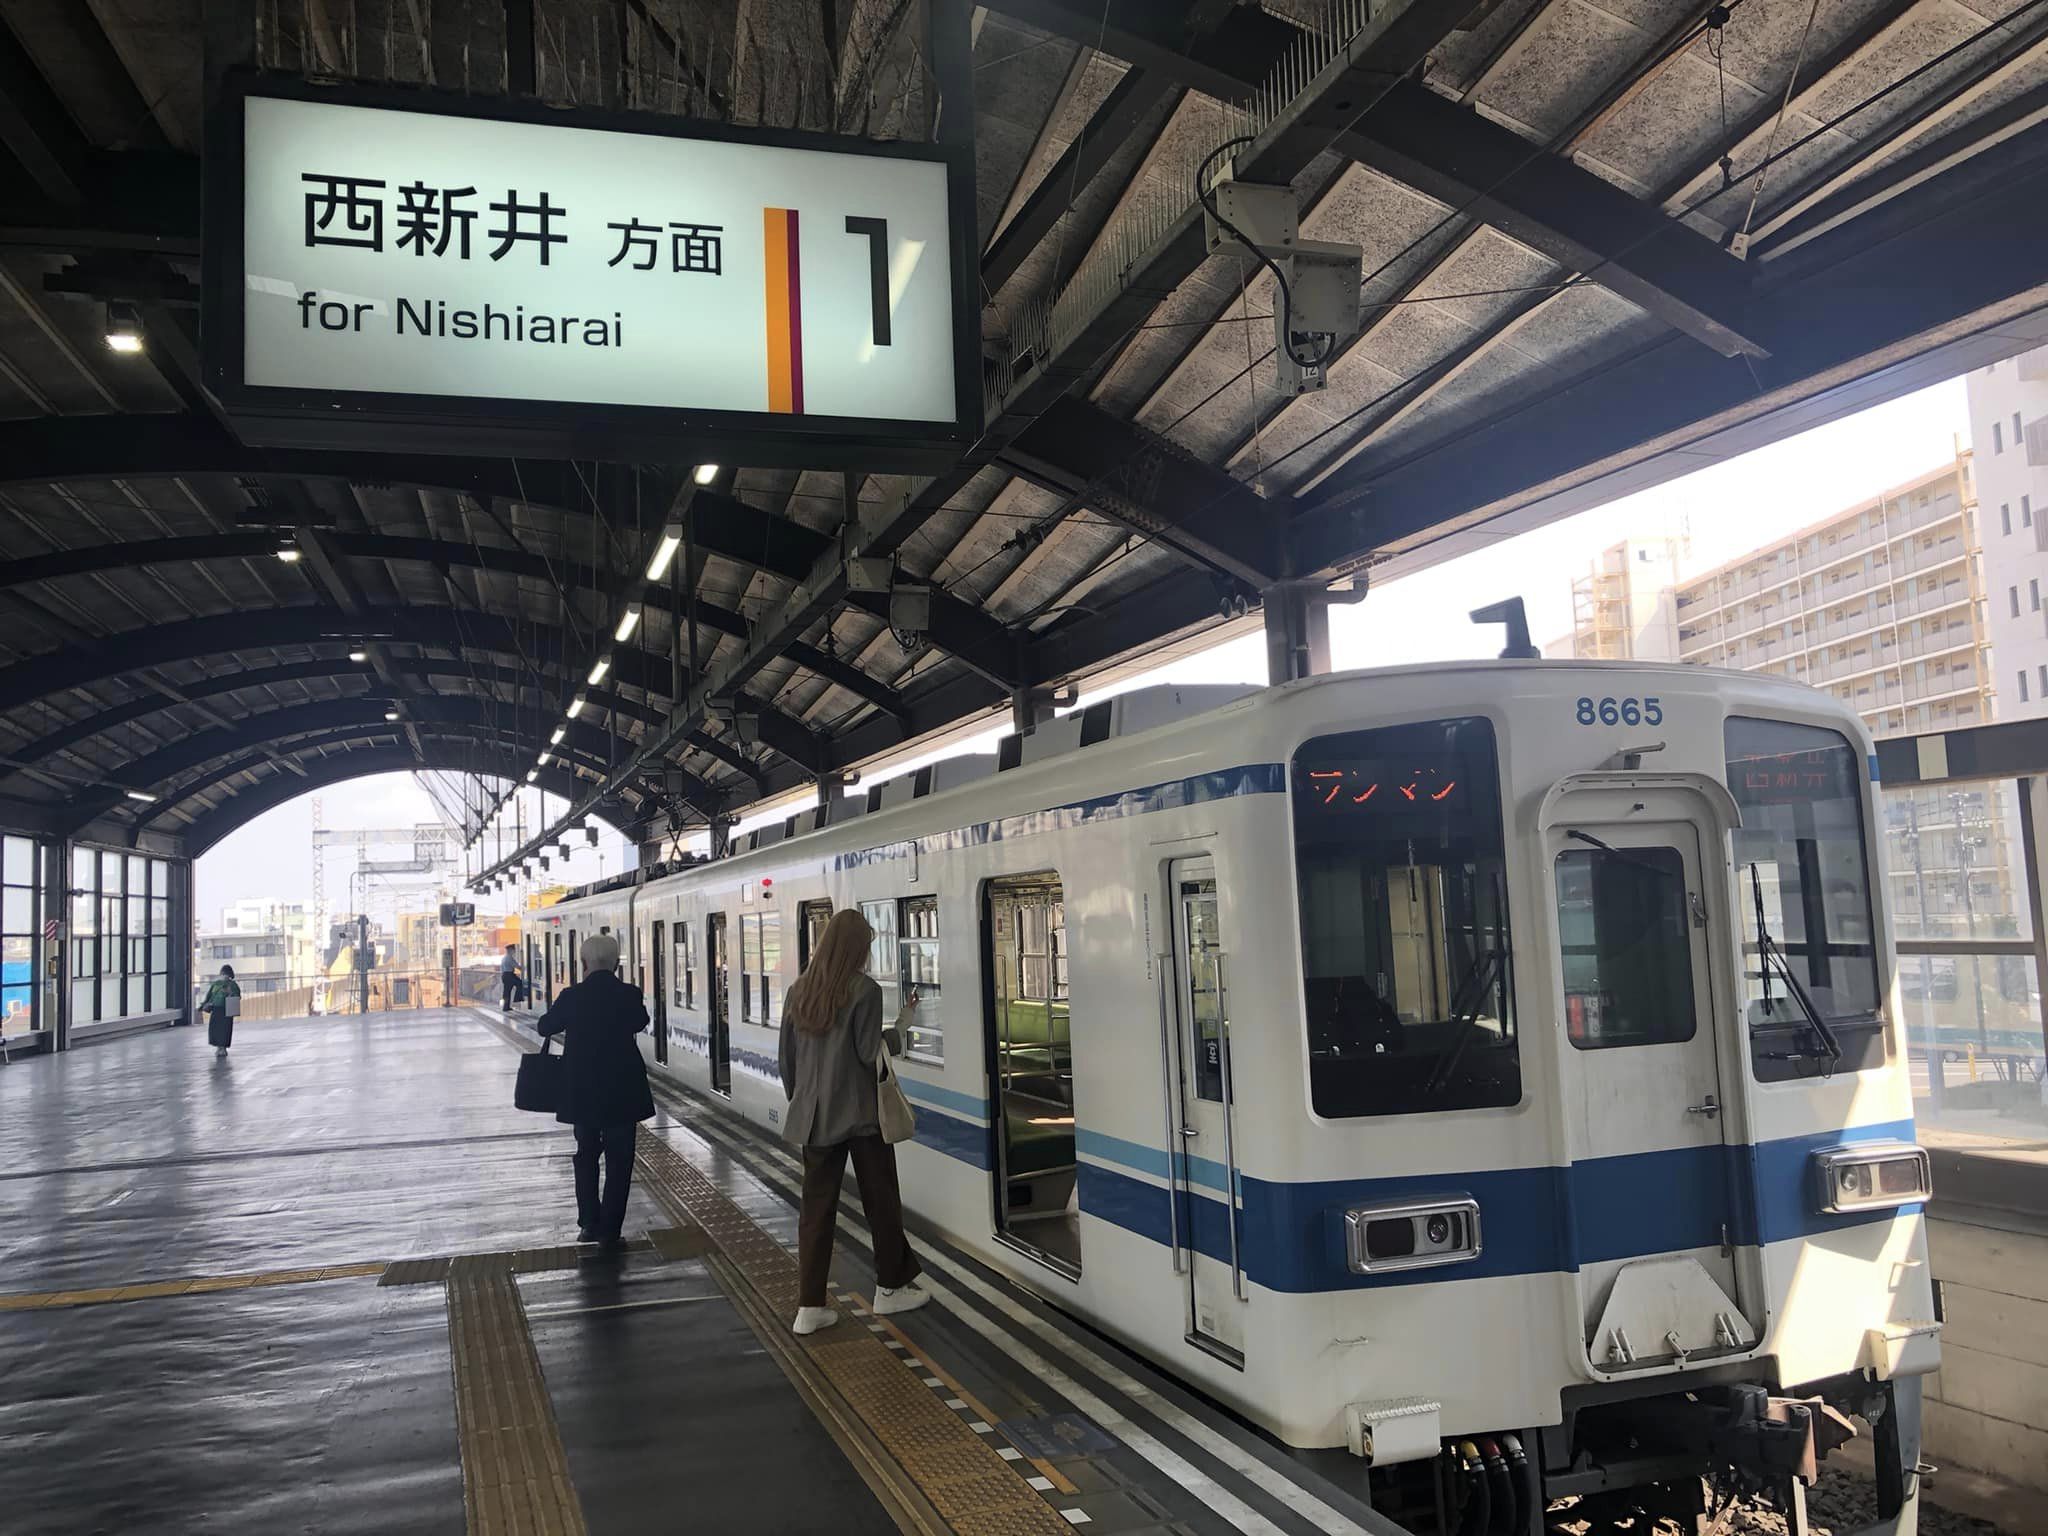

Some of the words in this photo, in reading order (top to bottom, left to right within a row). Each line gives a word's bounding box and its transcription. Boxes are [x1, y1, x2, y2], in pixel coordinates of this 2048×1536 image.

[301, 172, 568, 266] 西新井
[607, 217, 724, 276] 方面
[296, 291, 374, 332] for
[396, 297, 622, 347] Nishiarai
[844, 215, 892, 347] 1
[1576, 697, 1663, 726] 8665
